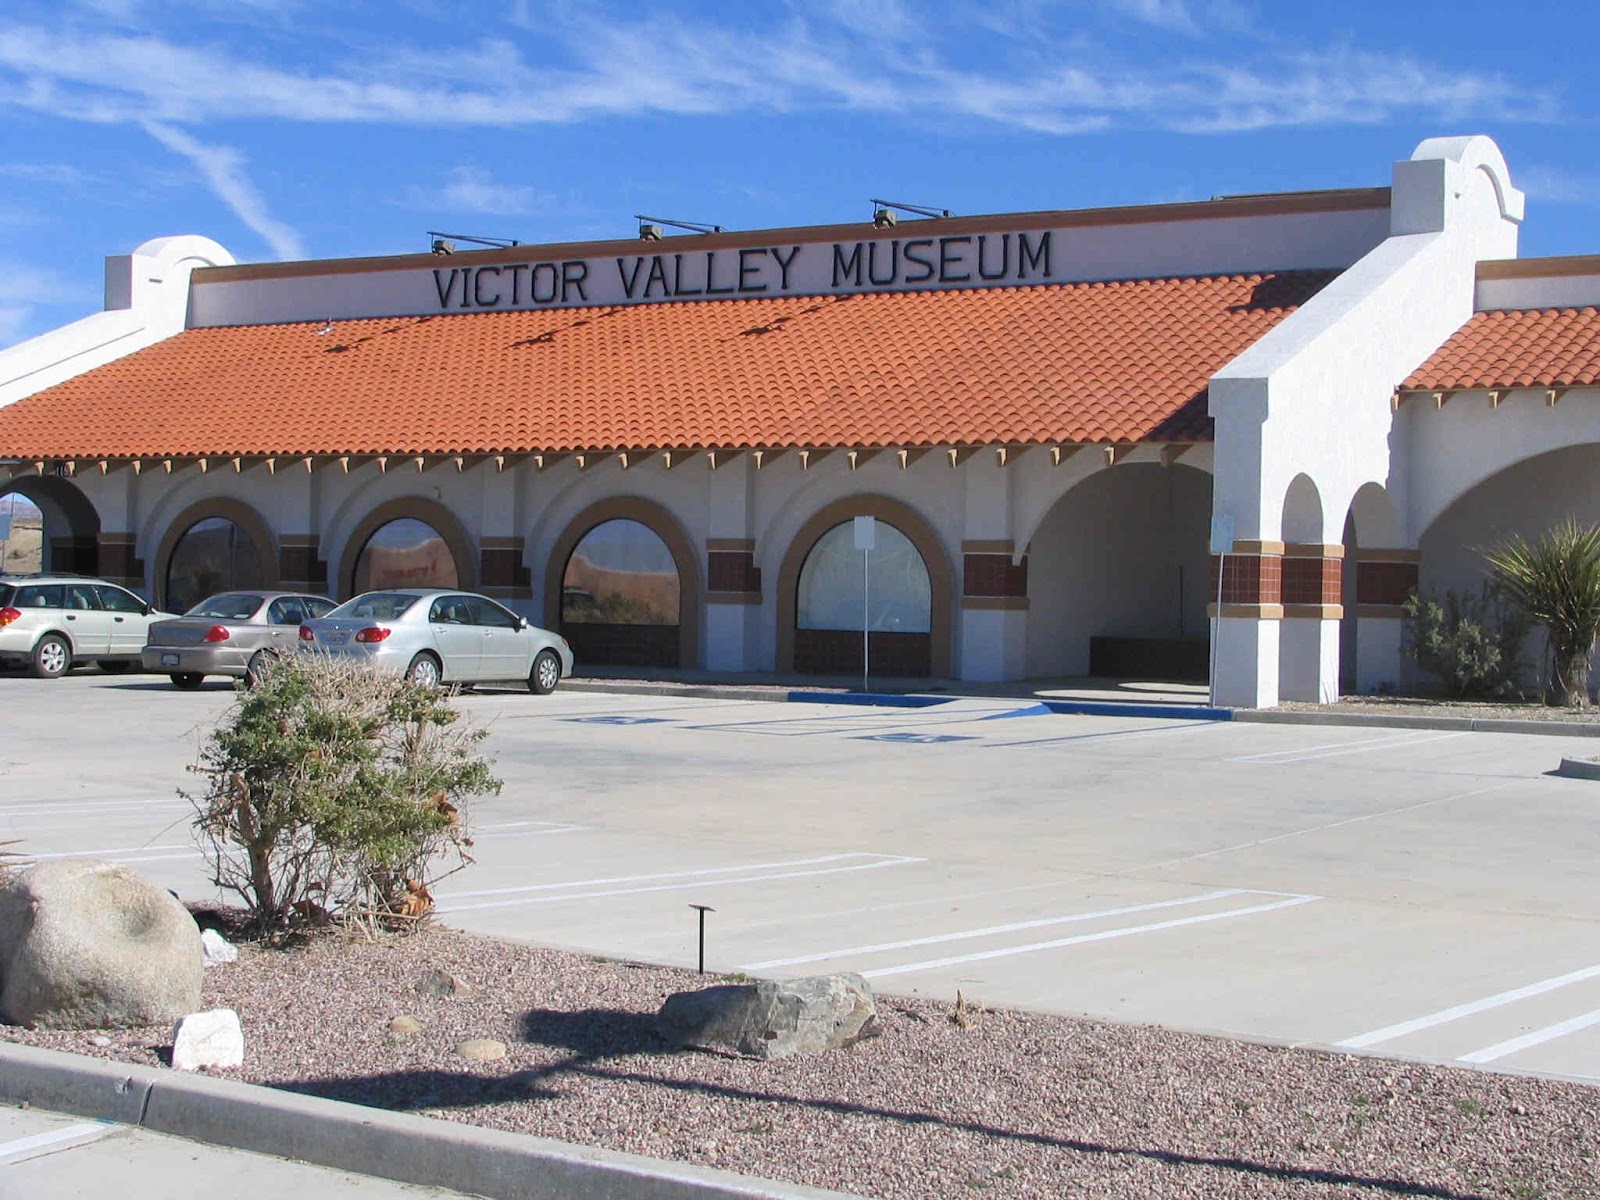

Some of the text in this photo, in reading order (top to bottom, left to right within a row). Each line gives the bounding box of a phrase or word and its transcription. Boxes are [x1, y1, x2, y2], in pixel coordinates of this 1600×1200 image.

[433, 231, 1052, 309] VICTOR VALLEY MUSEUM
